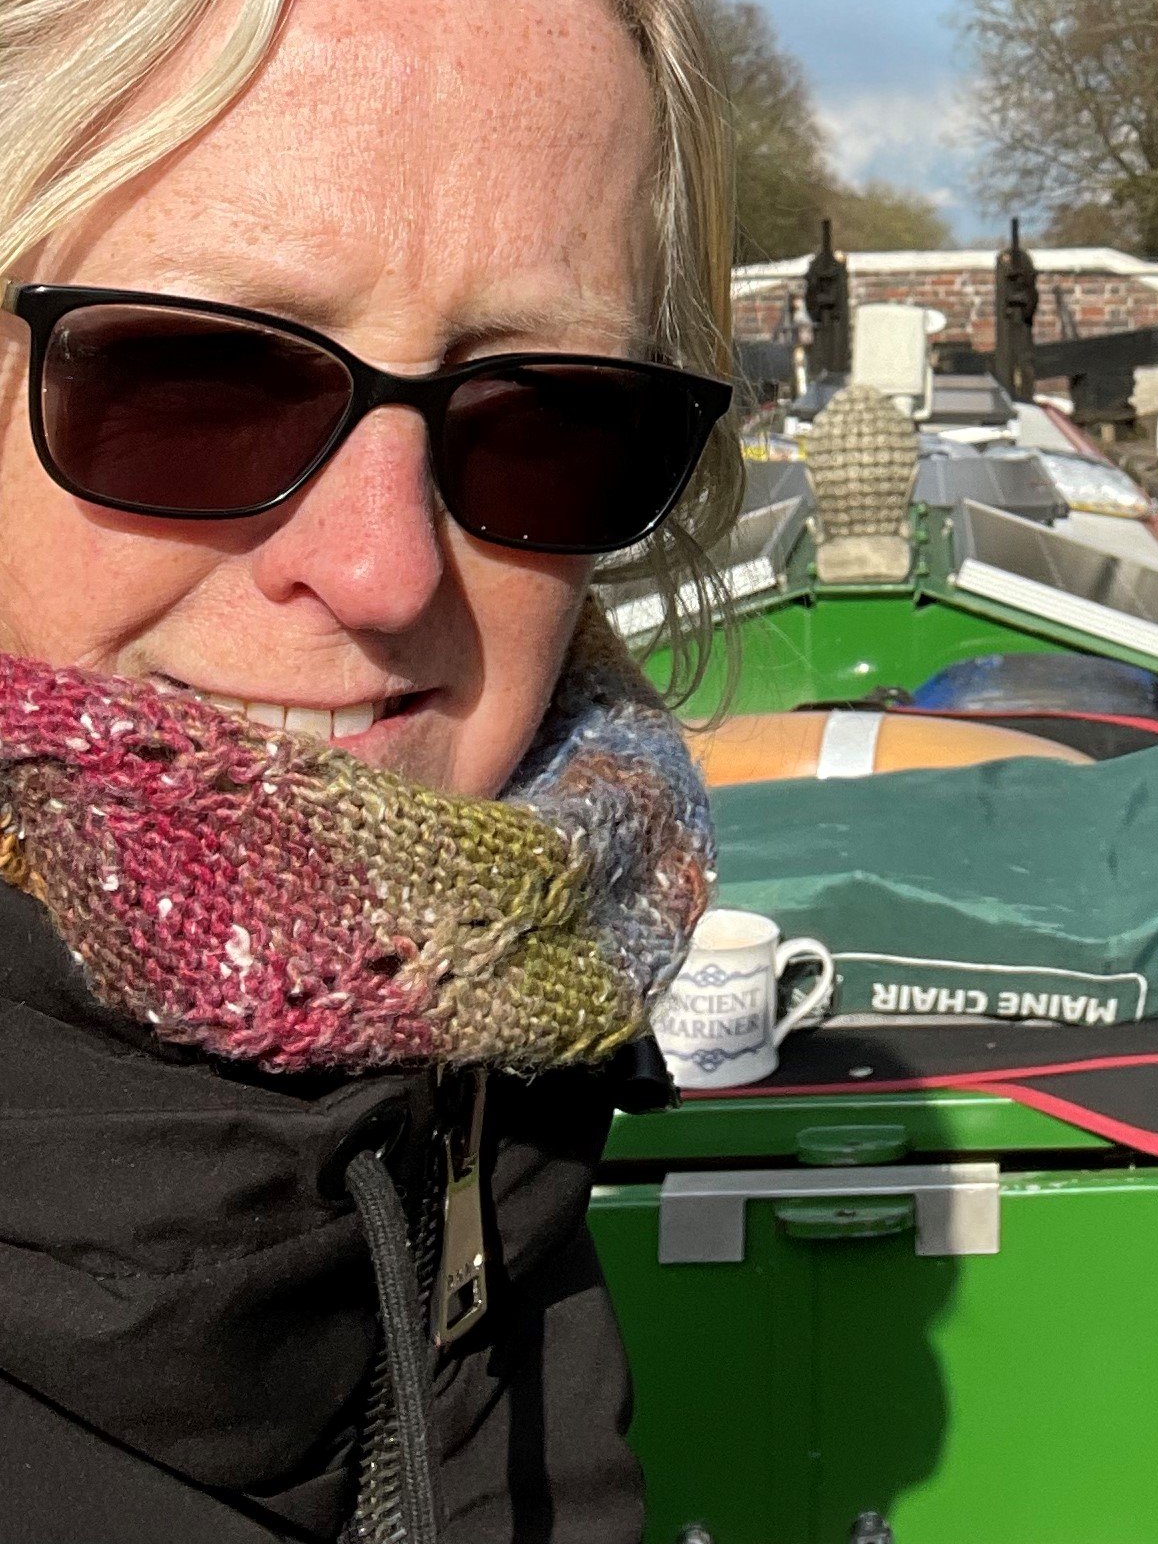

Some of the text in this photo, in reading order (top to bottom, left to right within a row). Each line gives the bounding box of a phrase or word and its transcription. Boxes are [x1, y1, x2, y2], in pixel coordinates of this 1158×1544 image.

[669, 987, 760, 1013] NCIENT
[871, 982, 1118, 1024] MAINE CHAIR
